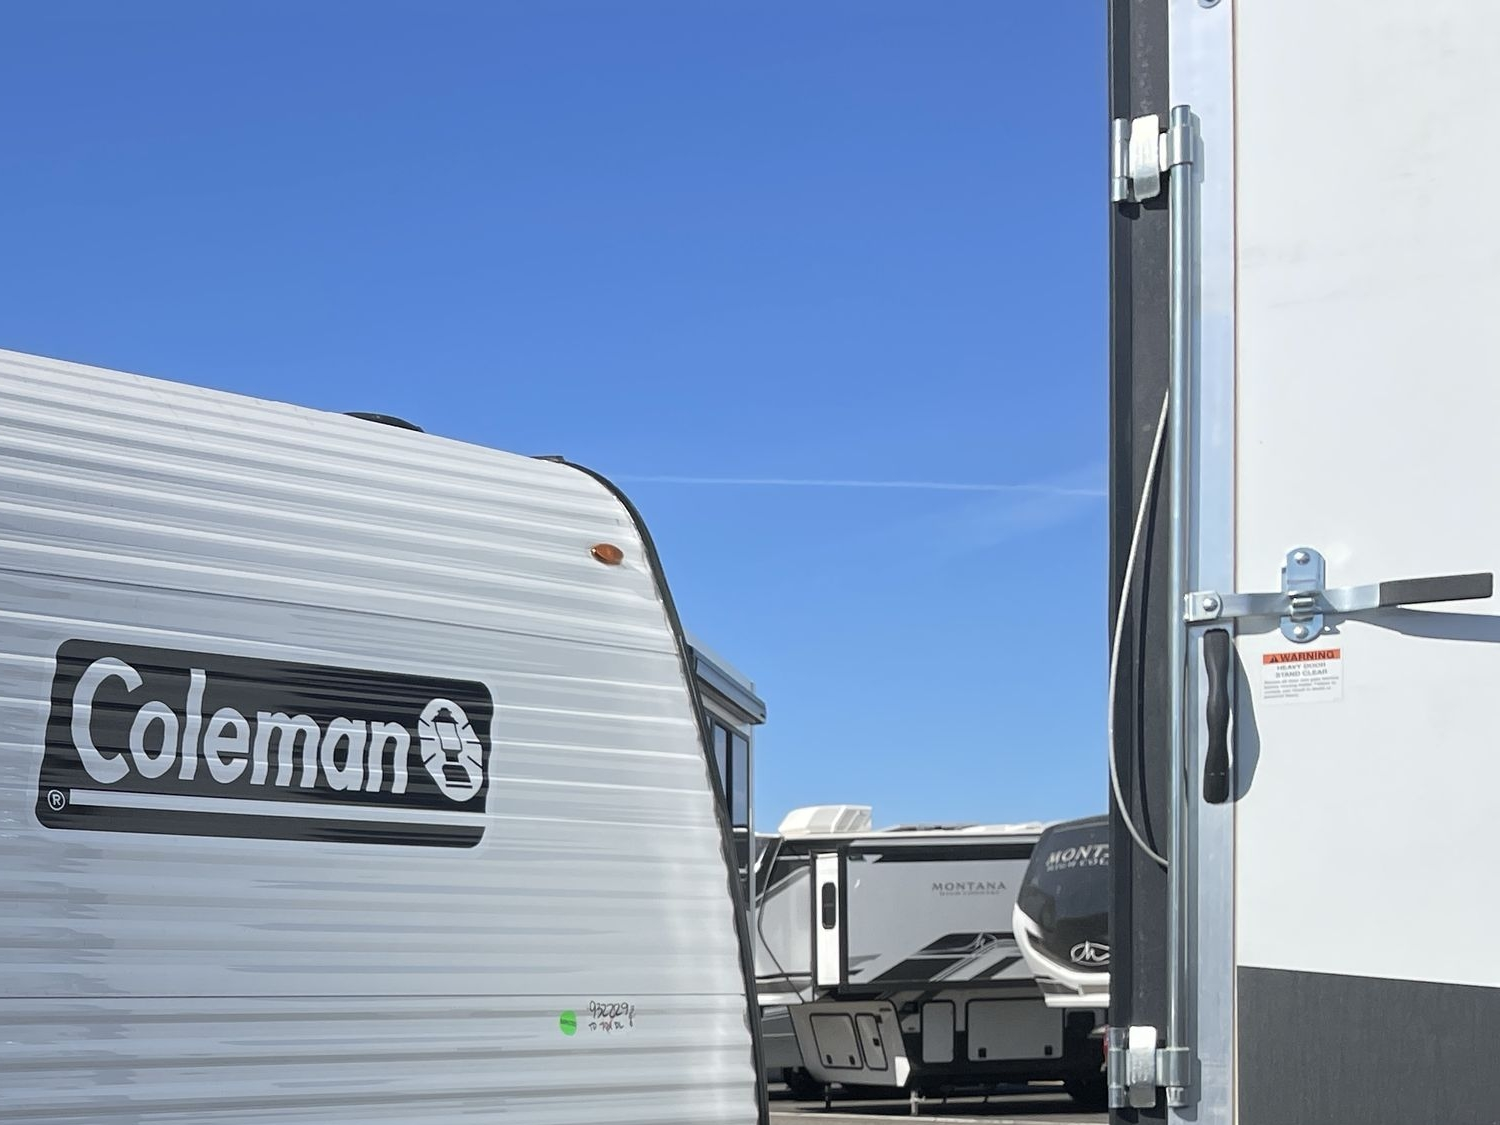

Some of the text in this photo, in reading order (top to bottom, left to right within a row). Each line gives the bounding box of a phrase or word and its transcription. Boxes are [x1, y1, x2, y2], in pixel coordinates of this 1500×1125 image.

[1281, 650, 1335, 663] WARNING
[71, 656, 409, 795] Coleman
[931, 881, 1007, 891] MONTANA
